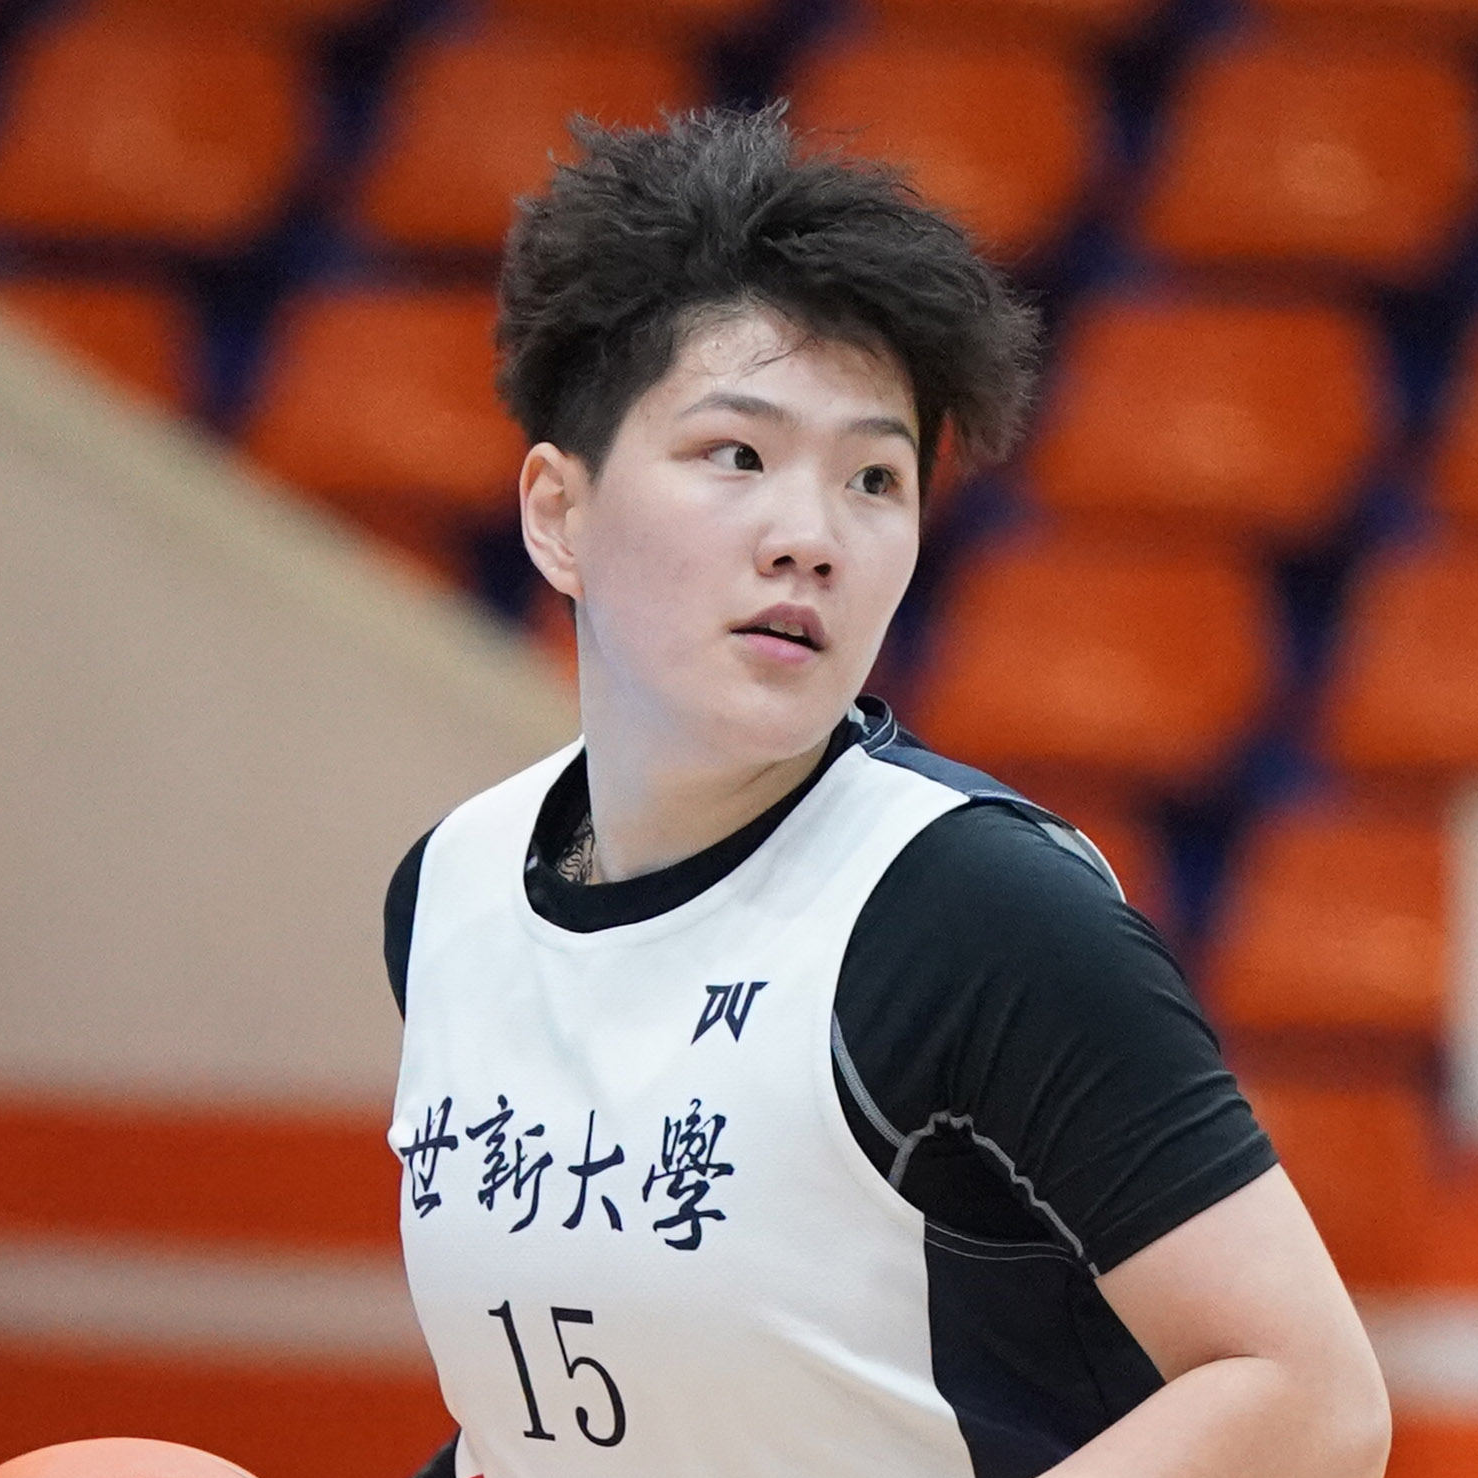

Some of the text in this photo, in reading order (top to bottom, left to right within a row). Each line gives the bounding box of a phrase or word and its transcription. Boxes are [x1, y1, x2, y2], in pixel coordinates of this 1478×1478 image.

[399, 1093, 735, 1251] 世新大學
[487, 1300, 627, 1447] 15
